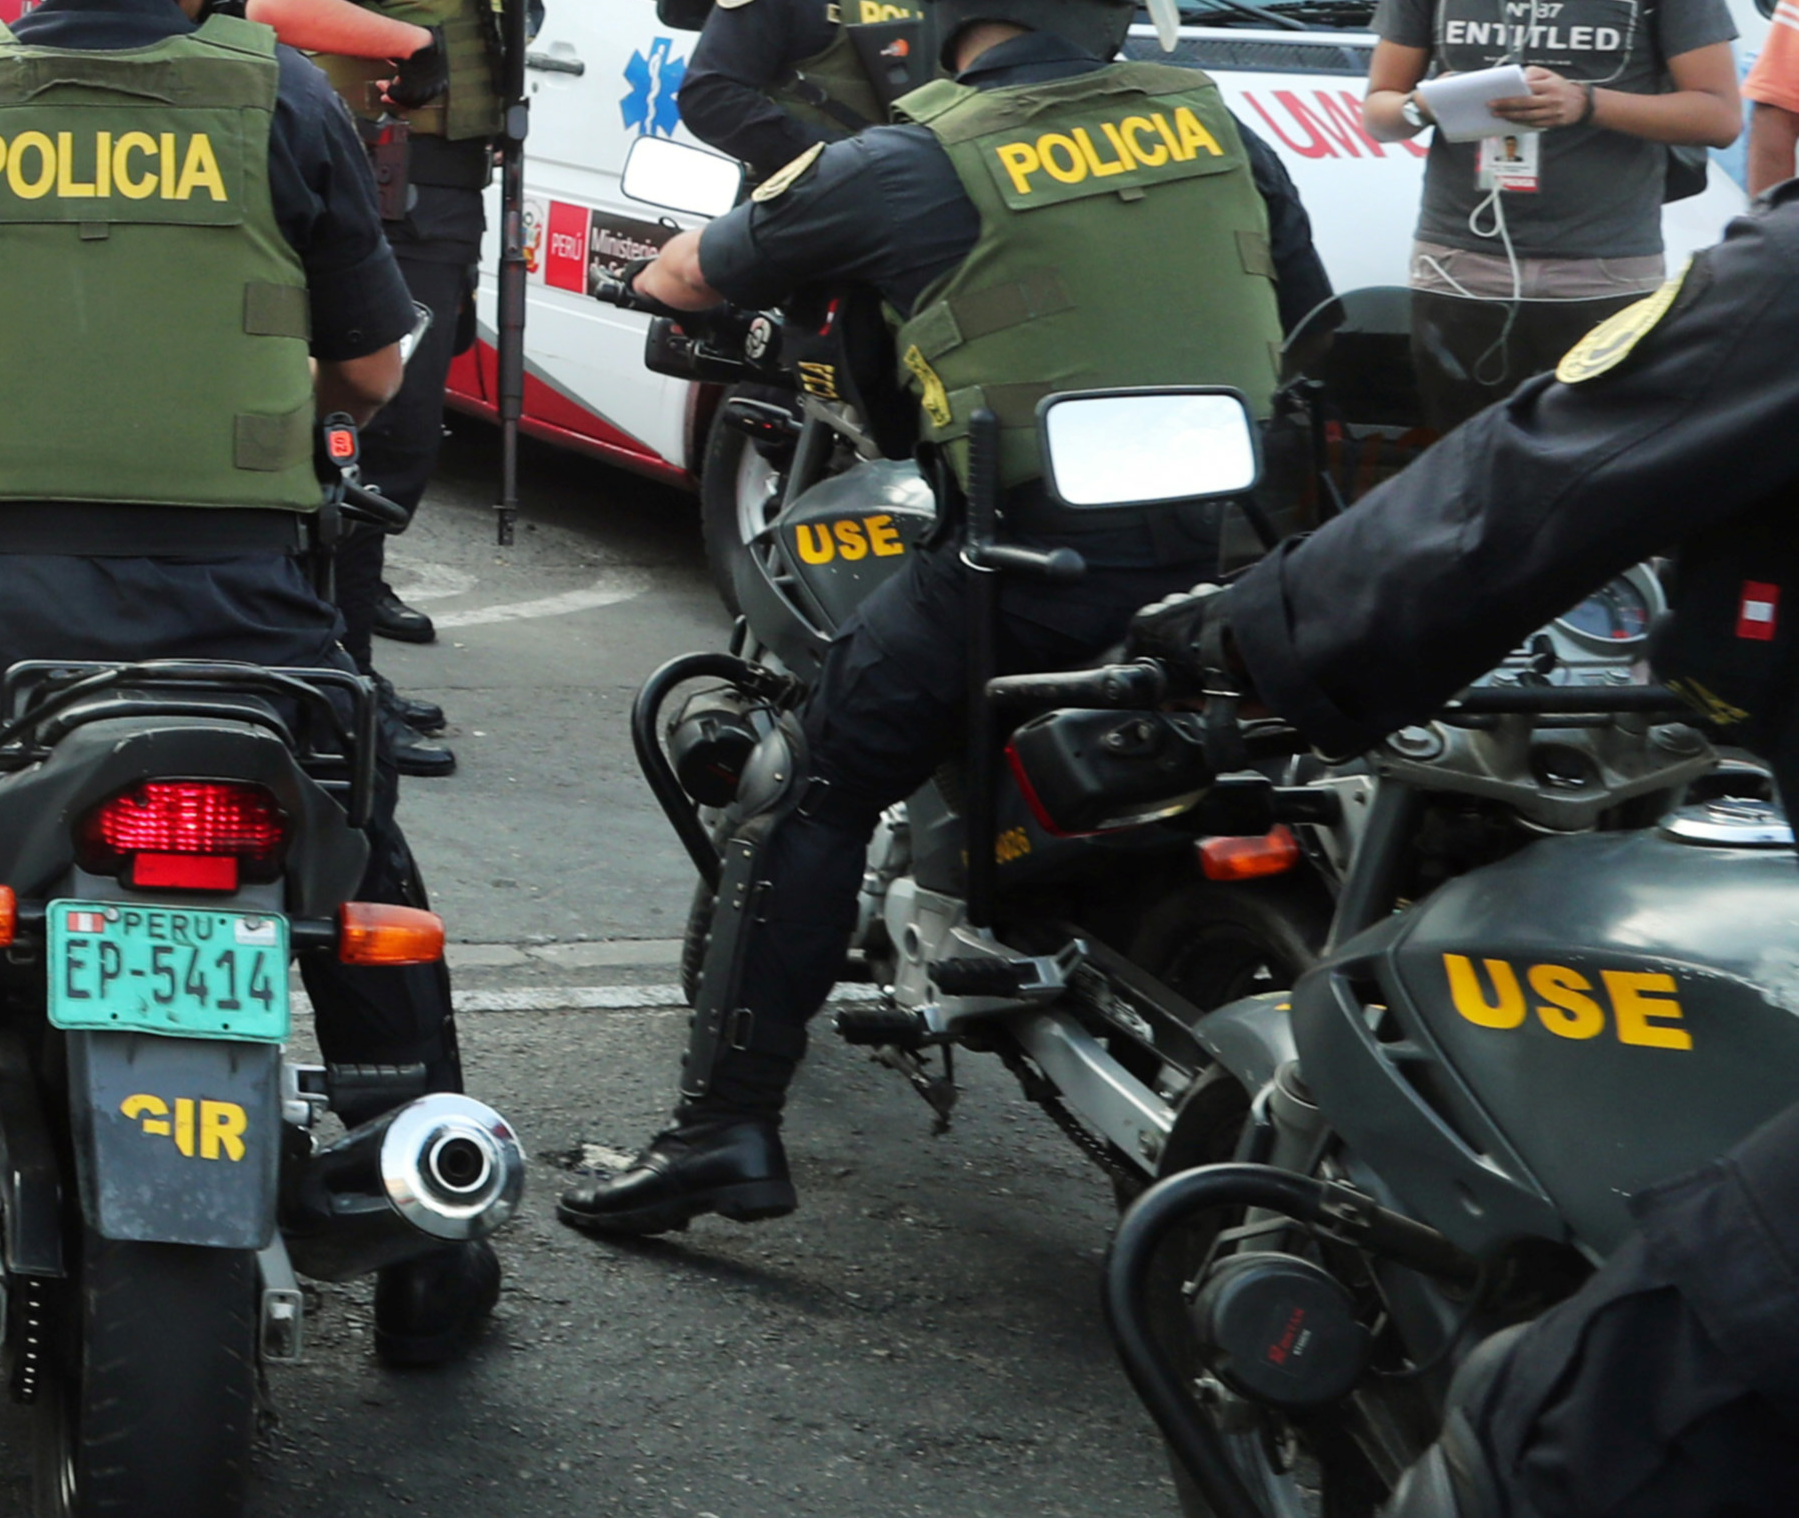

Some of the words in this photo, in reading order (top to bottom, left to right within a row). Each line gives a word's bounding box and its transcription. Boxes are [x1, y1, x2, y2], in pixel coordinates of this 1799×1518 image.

[1445, 20, 1621, 52] ENTITLED
[995, 106, 1224, 195] POLICIA
[552, 232, 583, 261] PERÚ
[590, 226, 659, 261] Ministerio
[795, 514, 905, 566] USE
[123, 911, 213, 941] PERU
[66, 939, 274, 1014] EP-5414
[1442, 953, 1693, 1051] USE
